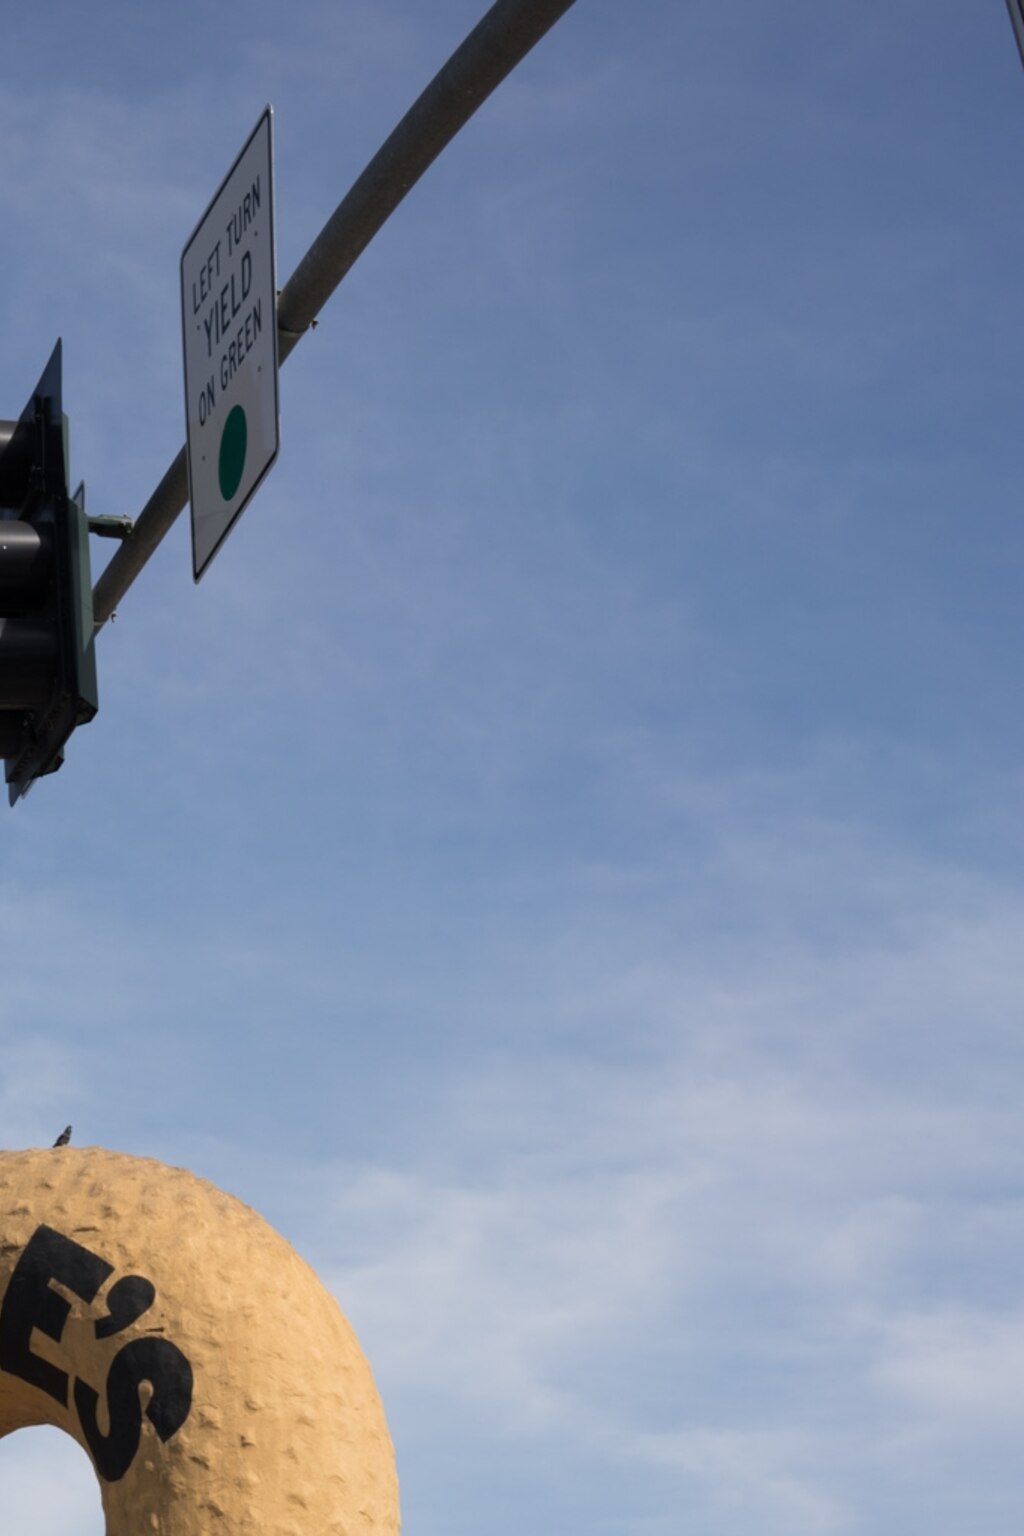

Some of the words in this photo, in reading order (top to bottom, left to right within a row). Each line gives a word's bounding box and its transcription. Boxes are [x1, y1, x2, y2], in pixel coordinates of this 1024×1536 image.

[192, 239, 221, 315] LEFT
[226, 175, 261, 256] TURN
[202, 250, 252, 358] YIELD
[198, 375, 215, 427] ON
[219, 299, 262, 392] GREEN
